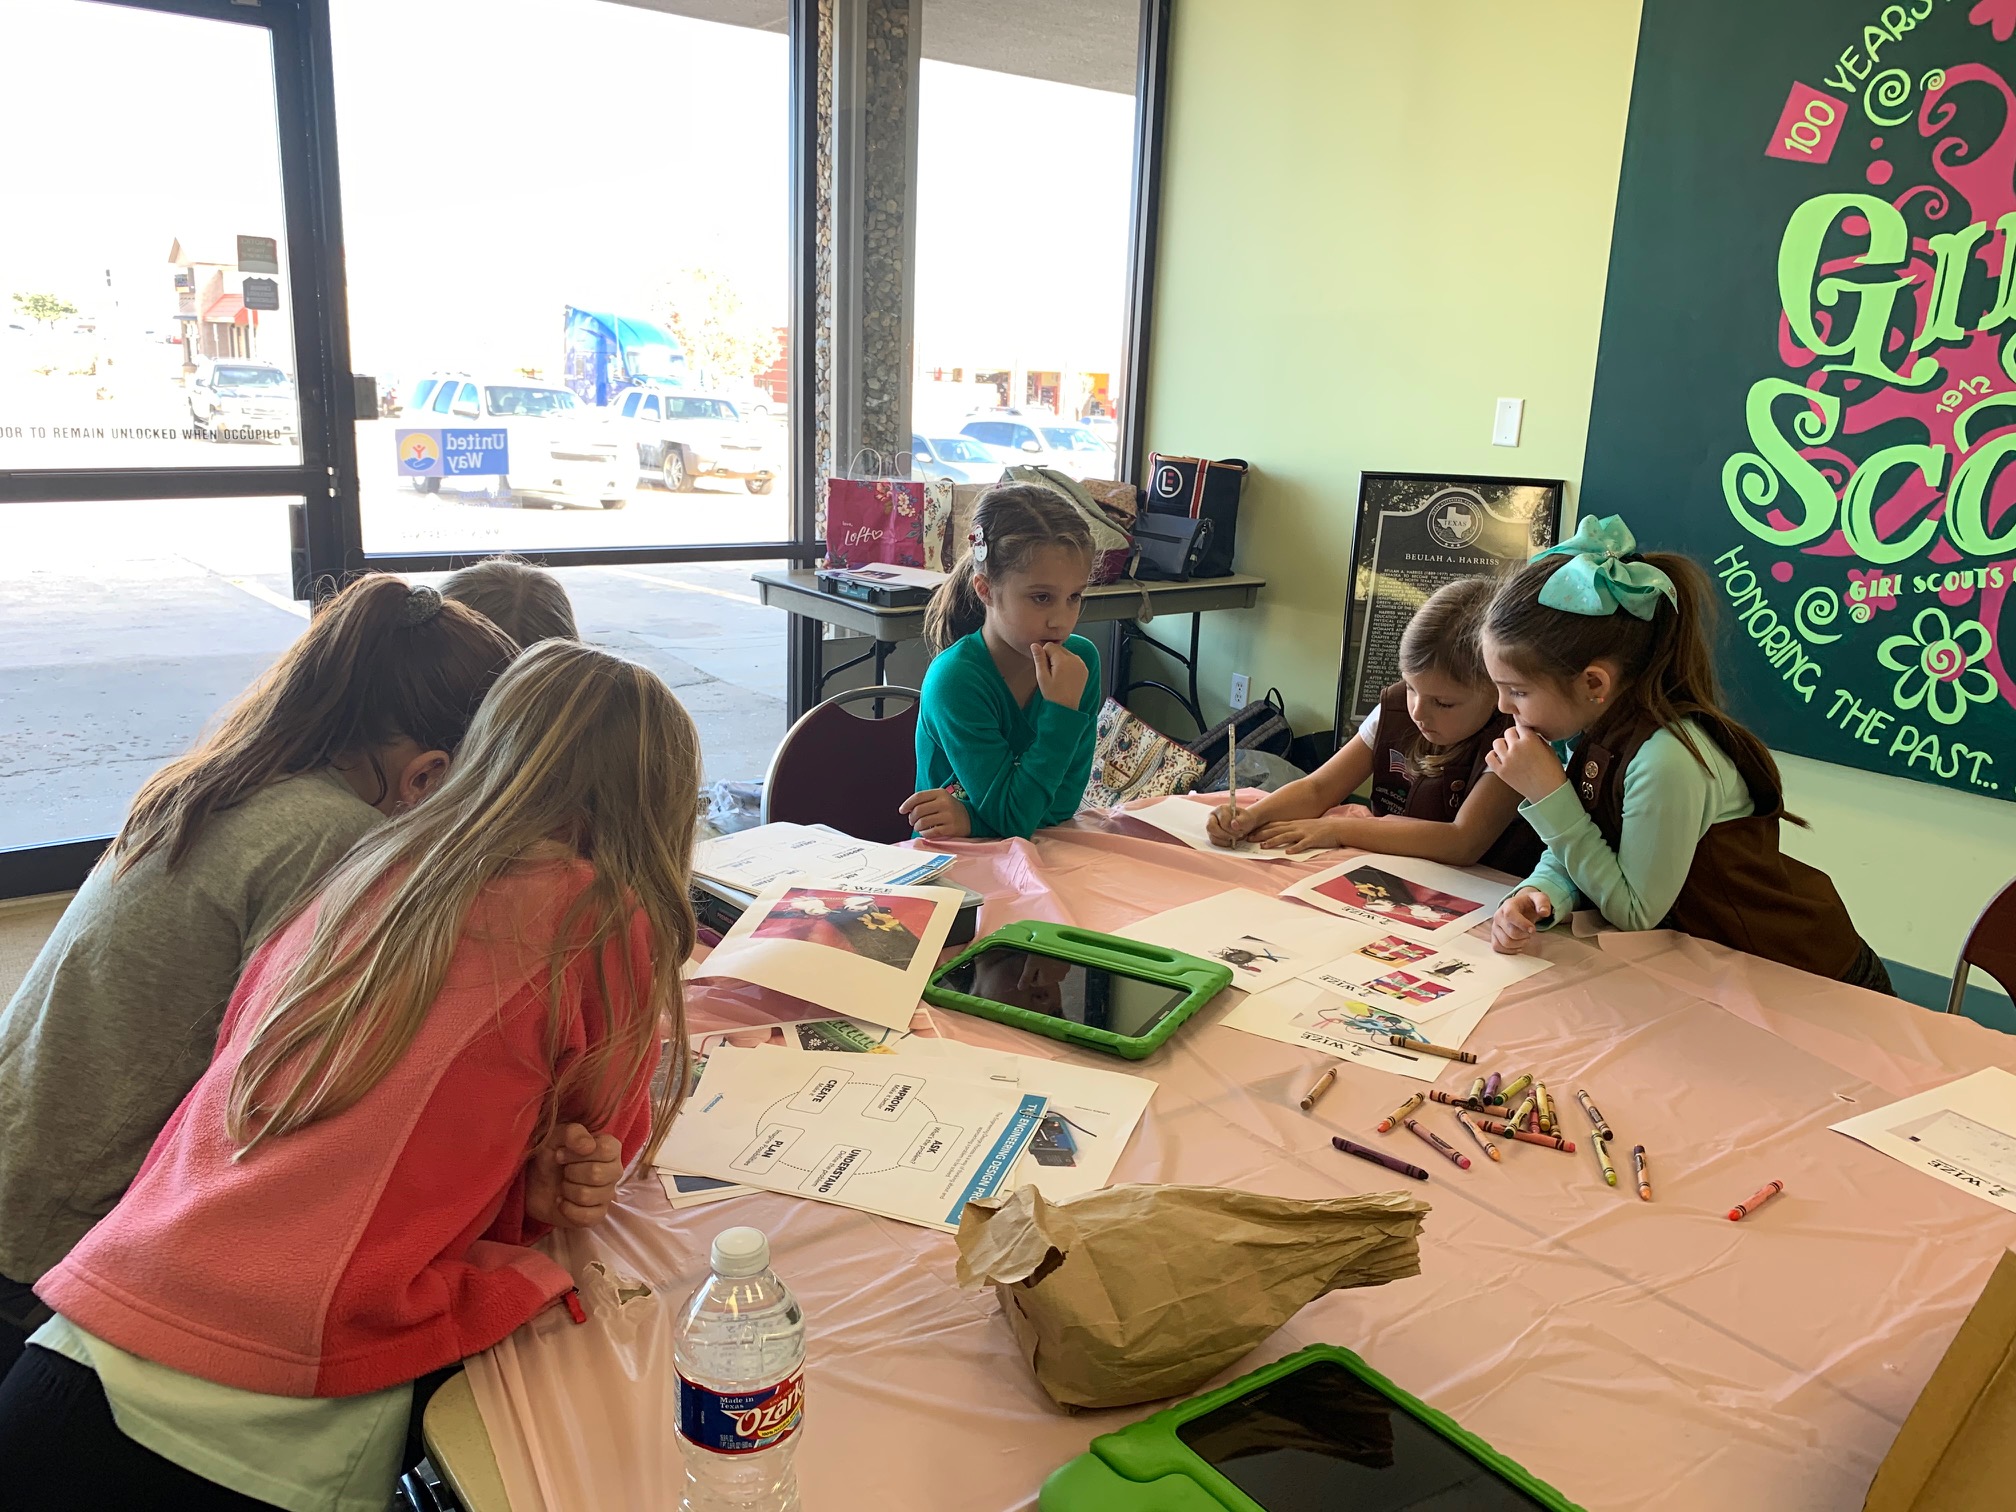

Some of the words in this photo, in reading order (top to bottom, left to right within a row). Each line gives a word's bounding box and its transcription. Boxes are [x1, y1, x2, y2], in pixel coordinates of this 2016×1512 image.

[1784, 100, 1835, 154] 100
[1823, 0, 1933, 93] YEARS
[1936, 375, 1994, 413] 1912
[30, 427, 46, 438] TO
[53, 427, 104, 438] REMAIN
[111, 428, 176, 439] UNLOCKED
[182, 429, 217, 440] WHEN
[844, 526, 872, 546] Loft
[1405, 553, 1443, 562] BEULAH
[1459, 556, 1500, 566] HARRISS
[1849, 574, 1902, 601] GIRL
[1913, 567, 2004, 594] SCOUTS
[1713, 545, 1821, 703] HONORING
[1826, 689, 1895, 744] THE
[1889, 725, 1998, 790] PAST...
[1319, 975, 1355, 992] WIZE
[1300, 1032, 1344, 1050] WIZE
[812, 1079, 837, 1102] CREATE
[884, 1084, 911, 1112] IMPROVE
[760, 1140, 783, 1158] PLAN
[926, 1139, 943, 1154] ASK
[996, 1118, 1029, 1160] ENGINEERING
[817, 1148, 860, 1193] UNDERSTAND
[978, 1161, 1002, 1187] DESIGN
[1928, 1160, 1981, 1188] WIZE
[736, 1382, 804, 1436] Ozark
